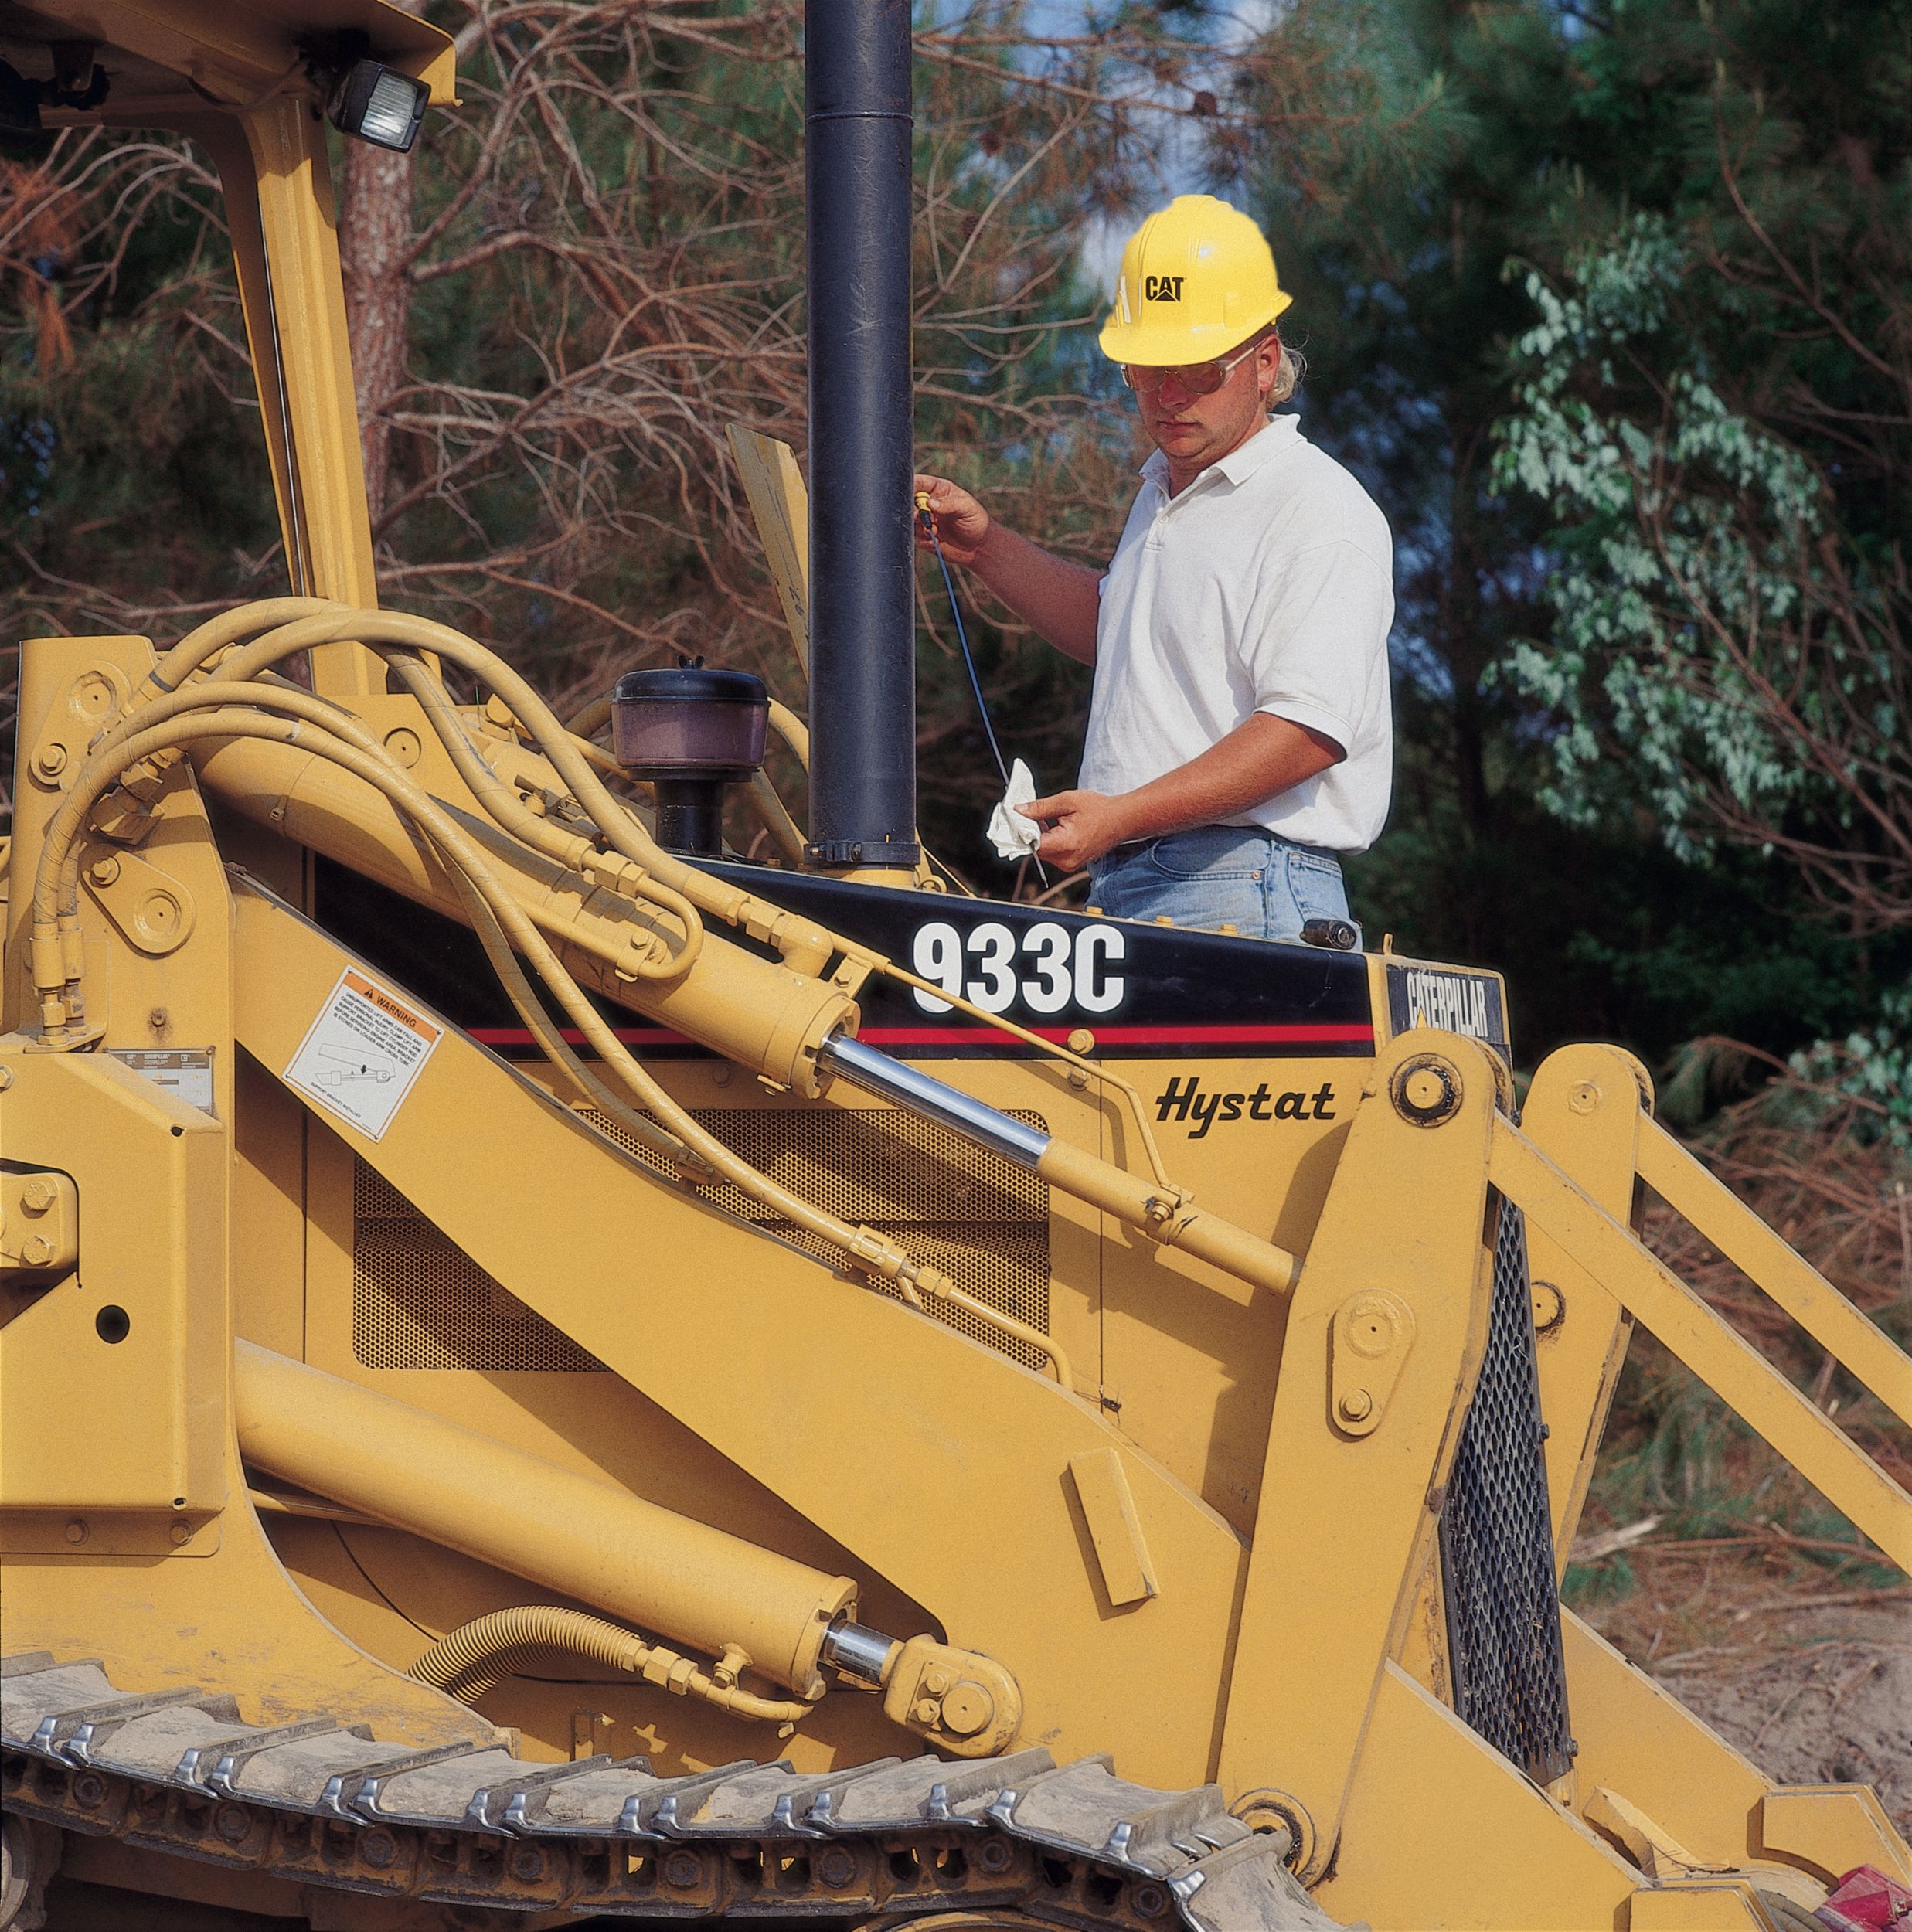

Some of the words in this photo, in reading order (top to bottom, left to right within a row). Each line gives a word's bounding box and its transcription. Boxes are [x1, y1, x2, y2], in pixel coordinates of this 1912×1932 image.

[1145, 276, 1184, 302] CAT
[913, 922, 1125, 1014] 933C
[375, 995, 417, 1027] WARNING
[1407, 971, 1488, 1037] CATERPILLAR
[1155, 1077, 1336, 1139] Hystat
